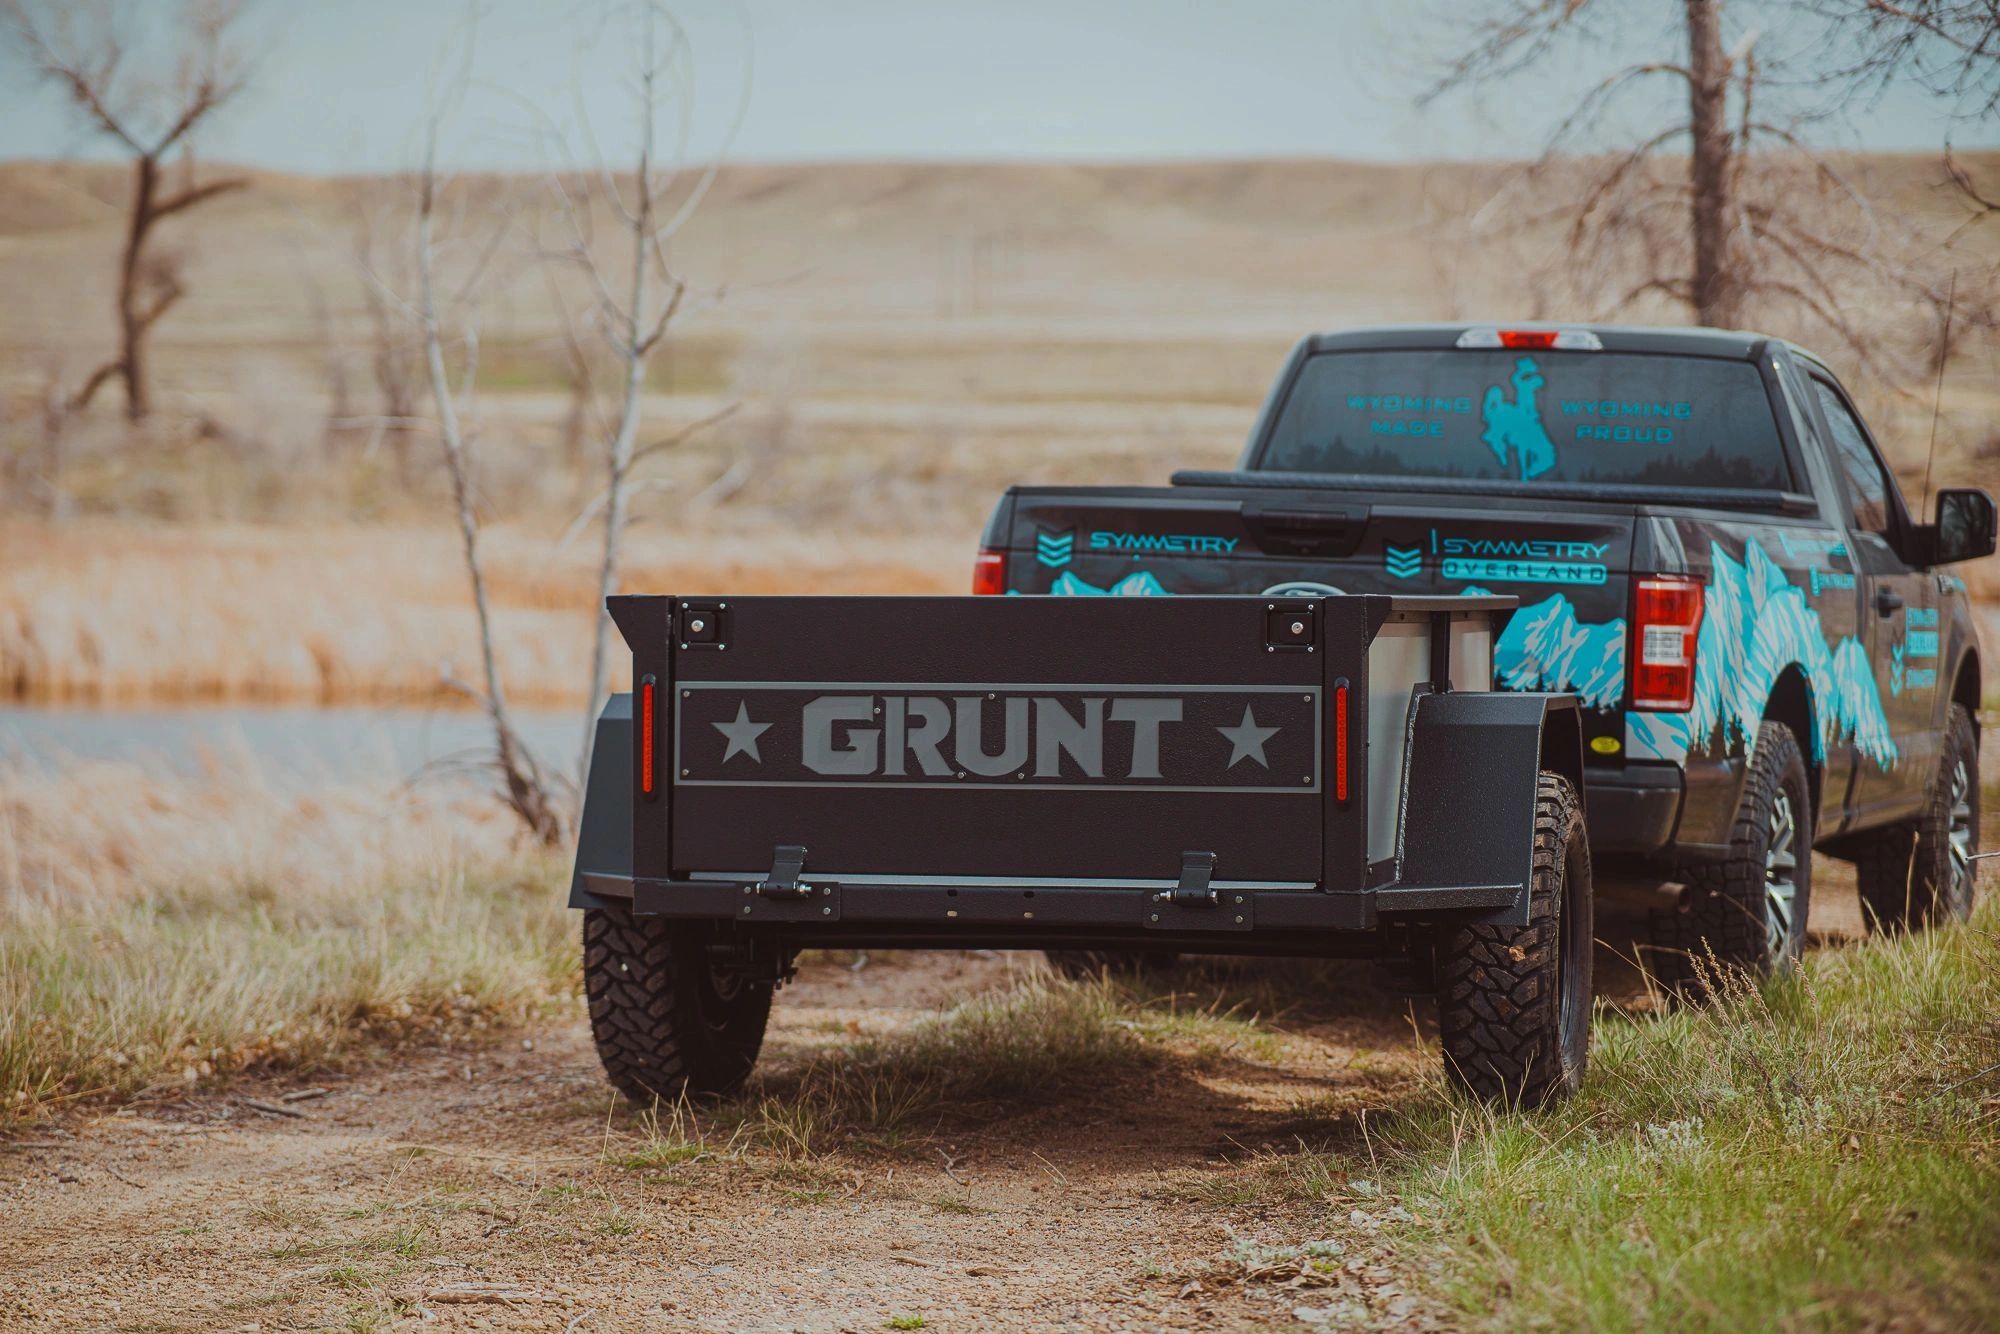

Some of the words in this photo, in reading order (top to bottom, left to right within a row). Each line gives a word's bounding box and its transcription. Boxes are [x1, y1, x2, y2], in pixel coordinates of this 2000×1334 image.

[1347, 395, 1472, 414] WYOMING
[1561, 400, 1692, 420] WYOMING
[1371, 420, 1445, 437] MADE
[1576, 425, 1674, 443] PROUD
[1090, 531, 1239, 552] SYMMETRY
[1443, 539, 1610, 559] SYMMETRY
[1444, 561, 1604, 580] OVERLAND
[801, 695, 1184, 778] GRUNT
